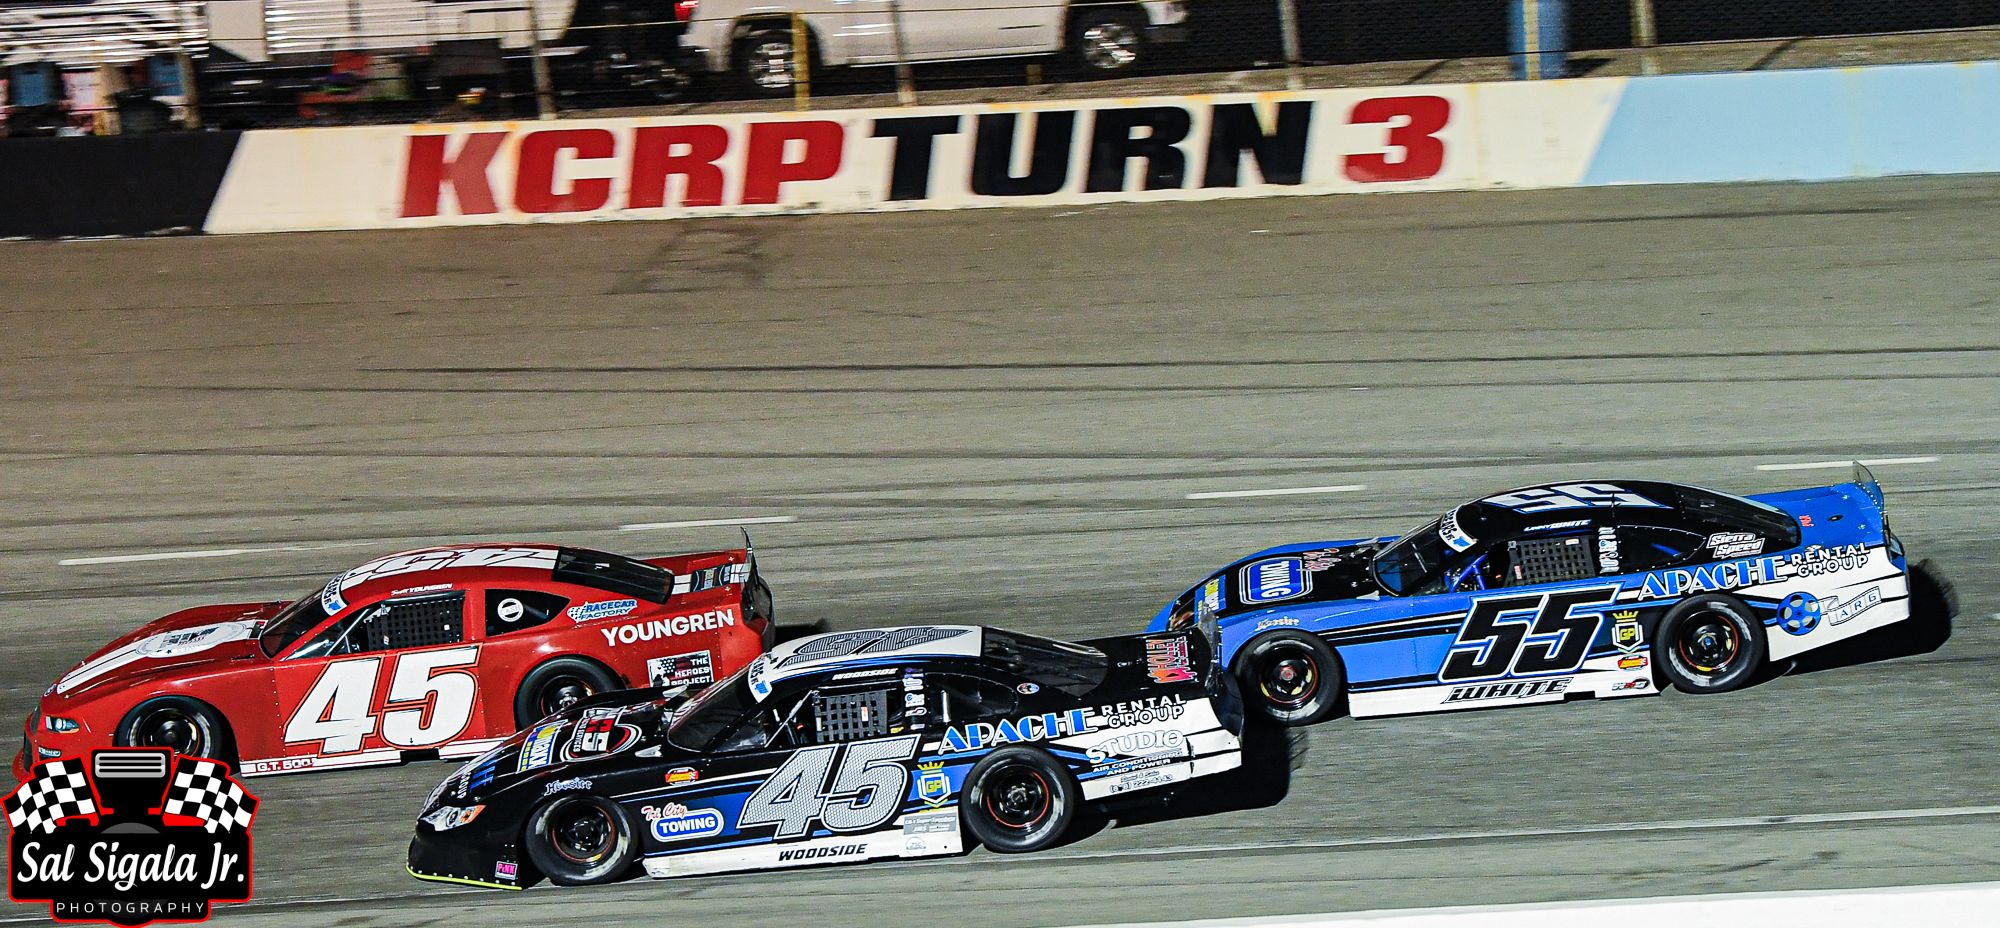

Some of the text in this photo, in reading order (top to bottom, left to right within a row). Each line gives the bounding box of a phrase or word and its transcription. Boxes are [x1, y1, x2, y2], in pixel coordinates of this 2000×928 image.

[401, 95, 1452, 219] KCRP TURN 3
[1709, 533, 1755, 547] Sierra
[1716, 541, 1763, 556] Speed
[1797, 555, 1869, 578] GROUP
[1637, 555, 1790, 601] APACHE
[580, 607, 631, 621] FACTORY
[584, 599, 637, 613] RACECAR
[600, 608, 735, 647] YOUNGREN
[1438, 583, 1623, 684] 55
[689, 657, 709, 667] THE
[673, 666, 710, 679] HEROES
[1440, 677, 1574, 704] WHITE
[284, 643, 482, 758] 45
[1108, 705, 1185, 729] GROUP
[938, 706, 1099, 754] APACHE
[1085, 729, 1184, 765] STUDIO
[256, 757, 312, 773] G.T. 500
[1107, 758, 1171, 775] AND POWER
[1111, 751, 1184, 769] CONDITIONING
[544, 777, 593, 796] Hoosier
[736, 733, 921, 840] 45
[925, 779, 943, 793] GP
[641, 802, 688, 821] Tri City
[659, 815, 716, 834] TOWING
[778, 842, 868, 862] WOODSIDE
